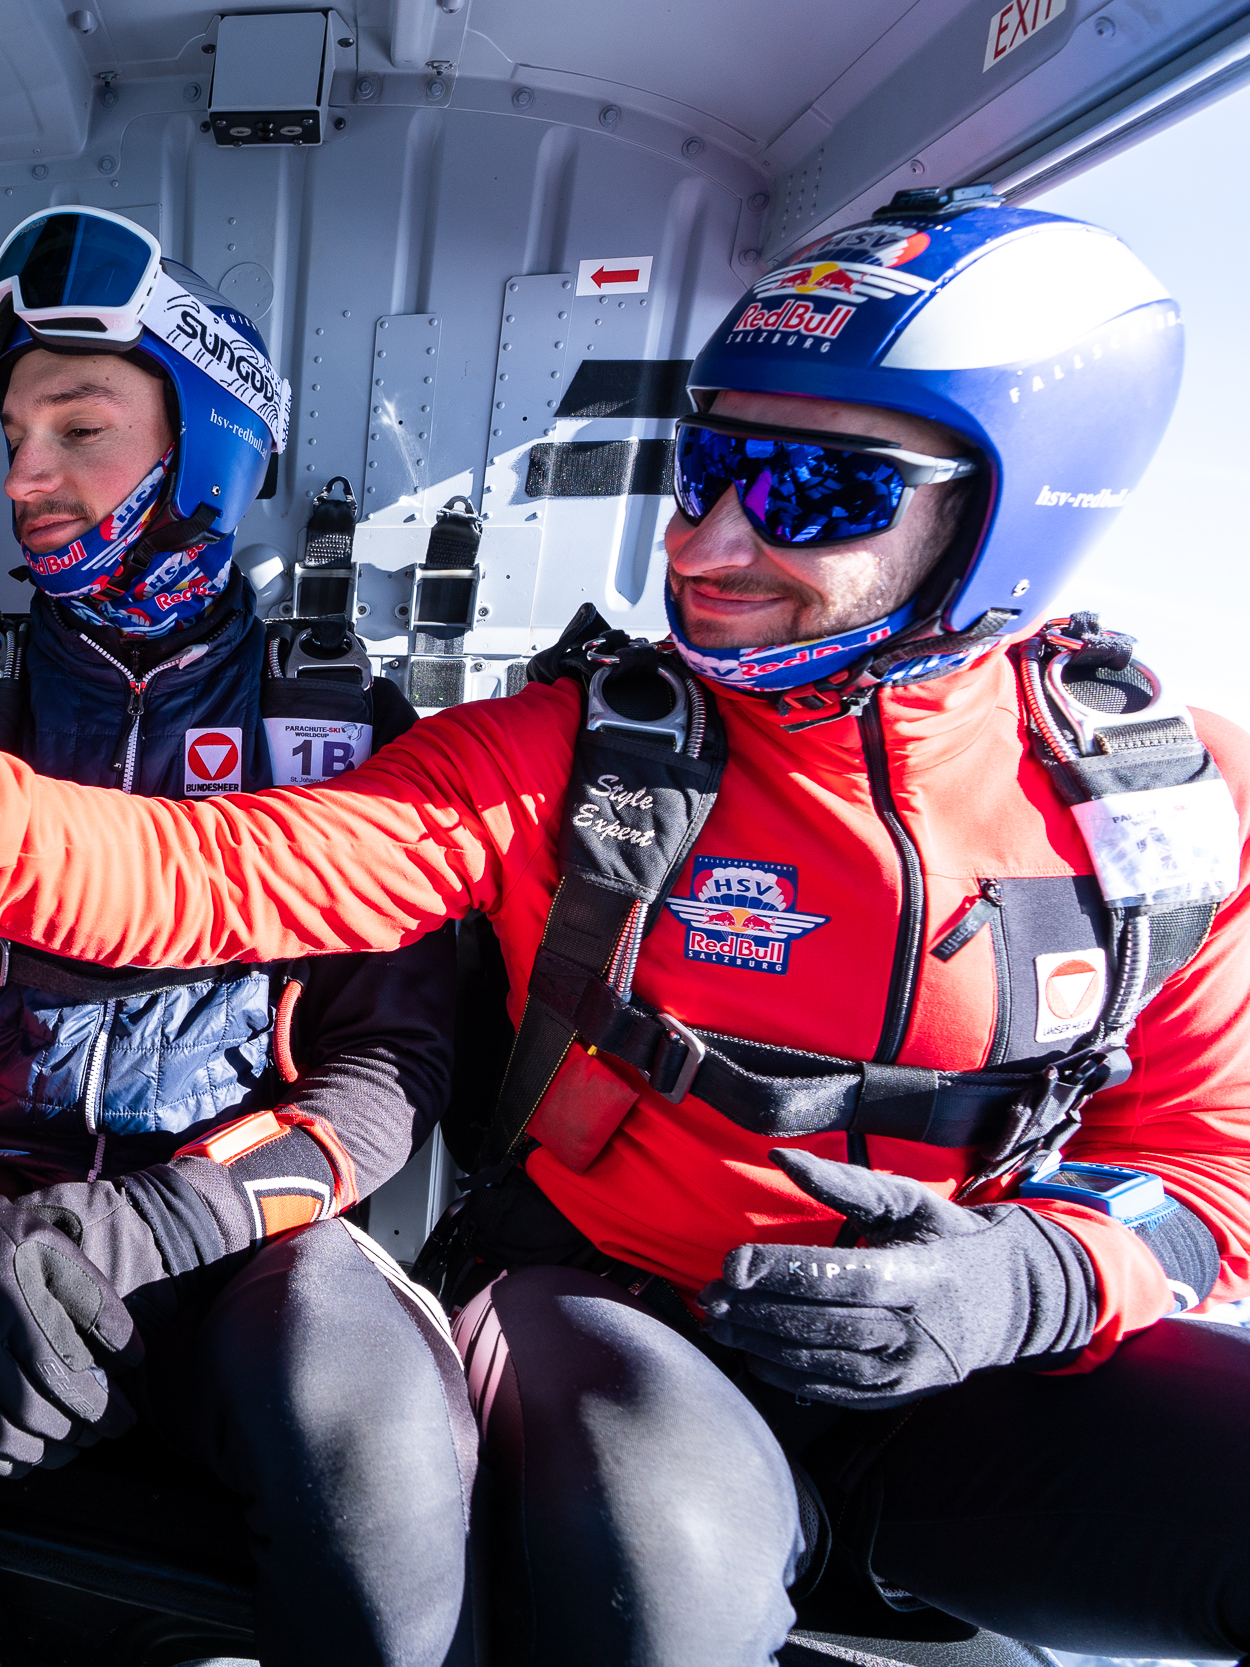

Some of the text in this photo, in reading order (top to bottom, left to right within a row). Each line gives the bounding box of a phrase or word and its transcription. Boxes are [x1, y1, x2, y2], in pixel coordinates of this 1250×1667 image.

[732, 299, 857, 340] Red Bull
[176, 310, 275, 402] SUNGOD
[725, 331, 831, 353] SALZBURG
[45, 540, 88, 574] Bull
[285, 725, 341, 734] PARACHUTE-SKI
[185, 783, 239, 793] BUNDESHEER
[590, 774, 654, 810] Style
[572, 803, 656, 847] Expert
[713, 878, 774, 897] HSV
[688, 950, 782, 972] SALZBURG
[689, 930, 785, 963] Red Bull
